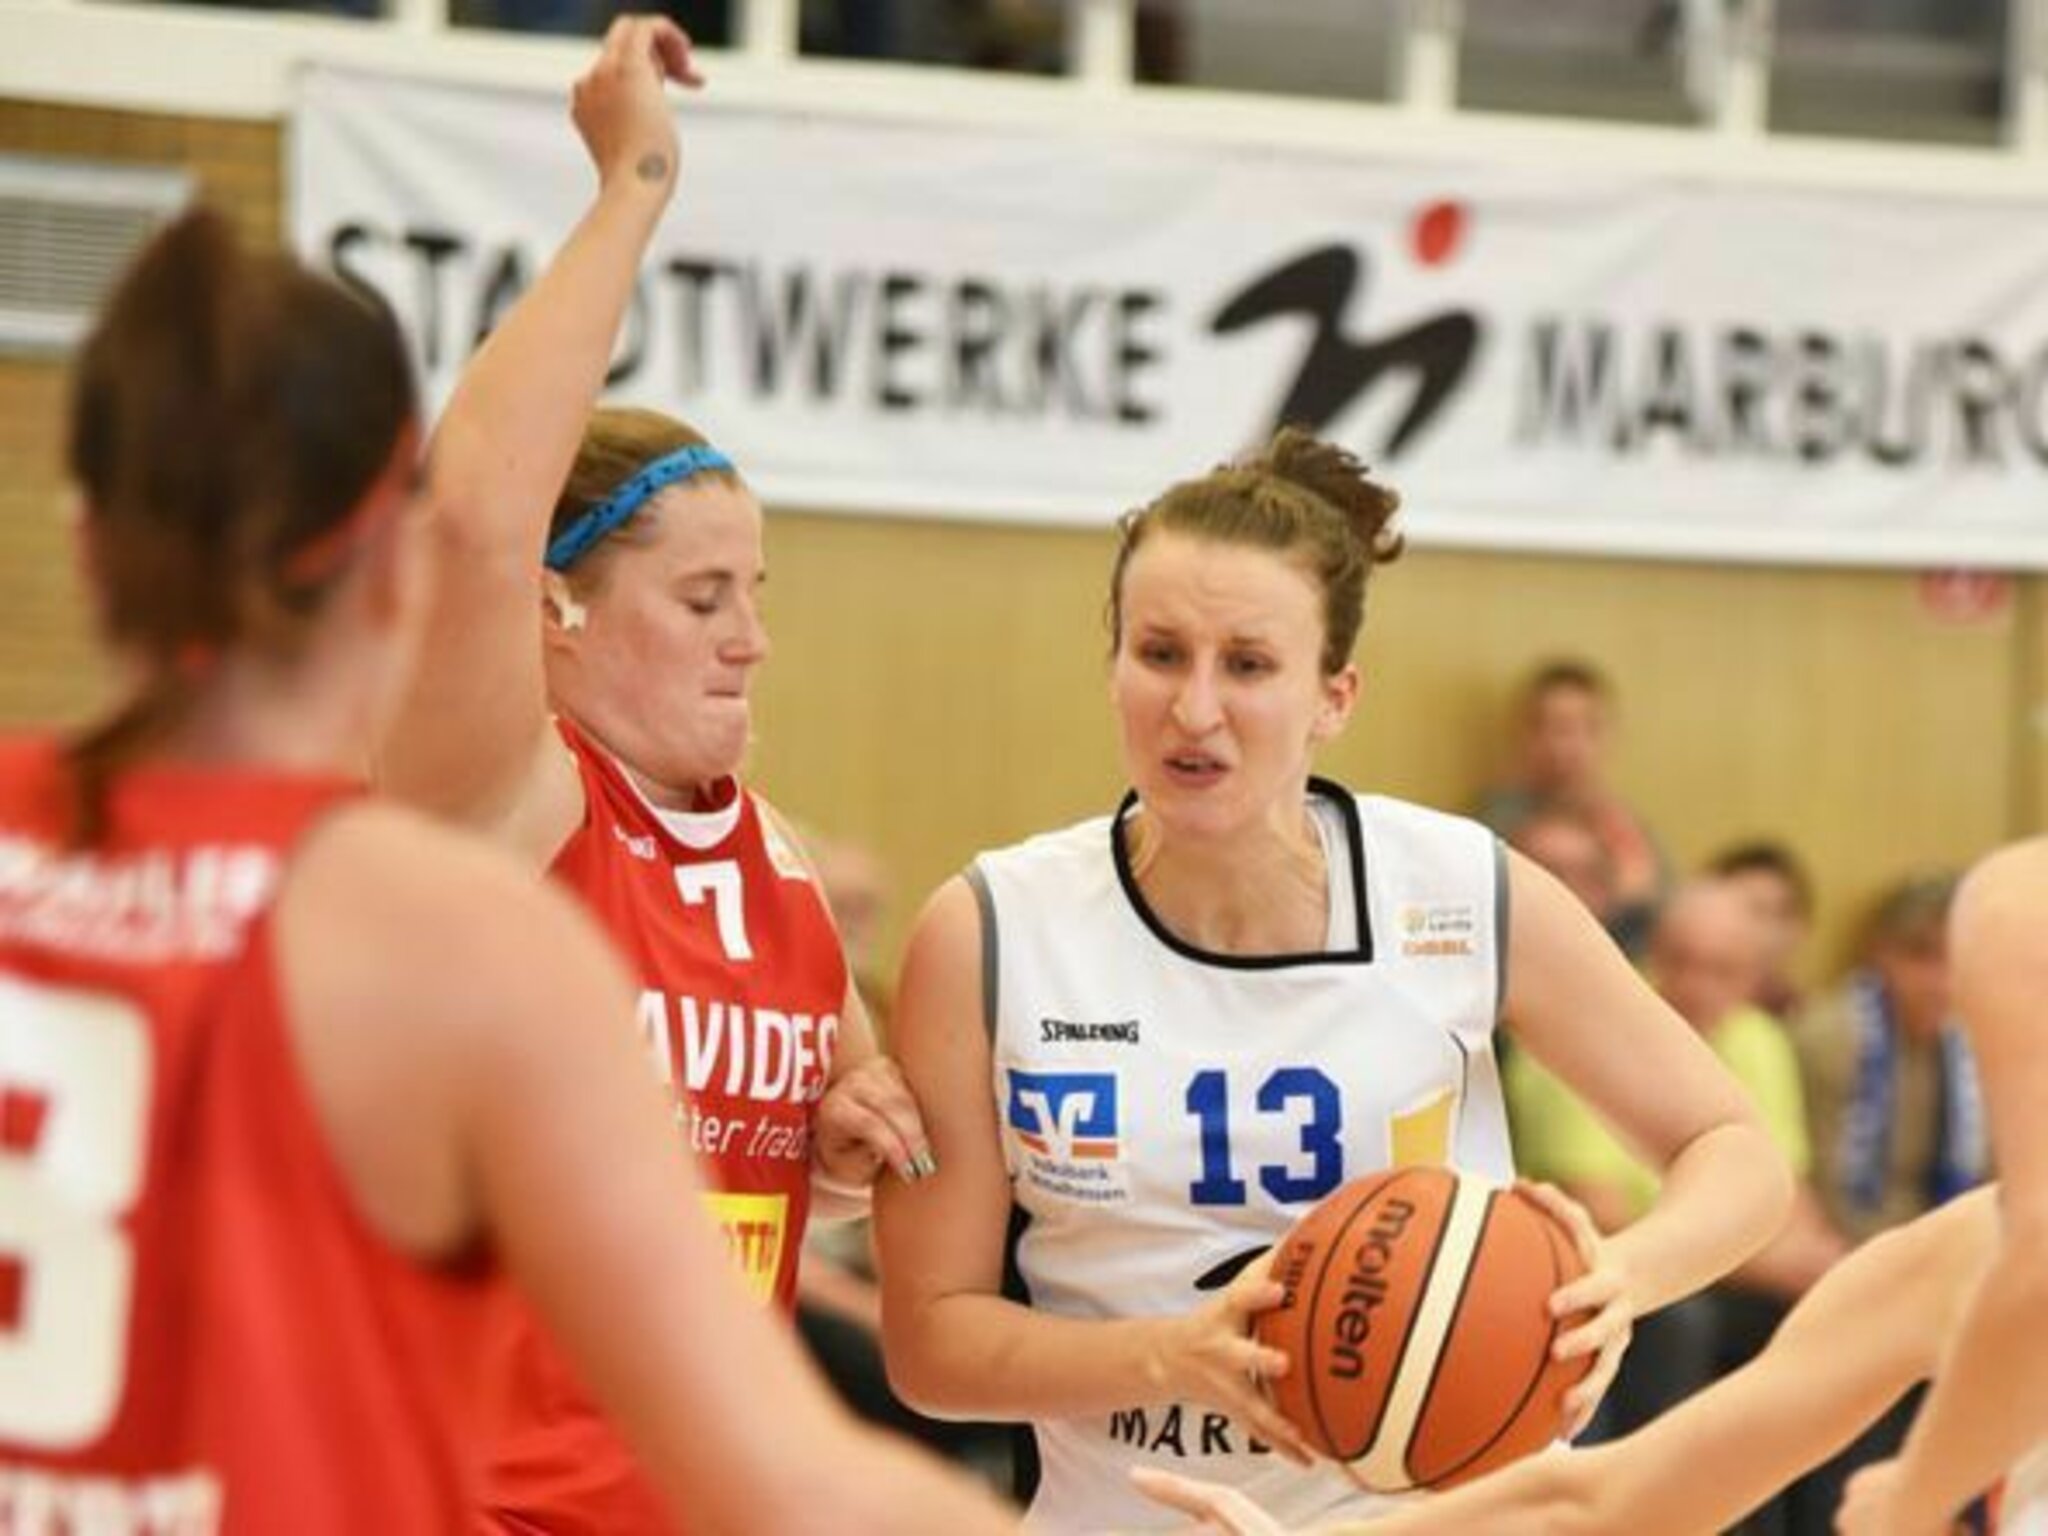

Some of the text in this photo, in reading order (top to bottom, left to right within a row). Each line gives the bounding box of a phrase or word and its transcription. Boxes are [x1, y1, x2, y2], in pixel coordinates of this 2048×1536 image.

[674, 860, 753, 961] 7
[1187, 1066, 1344, 1206] 13
[1329, 1199, 1415, 1380] molten
